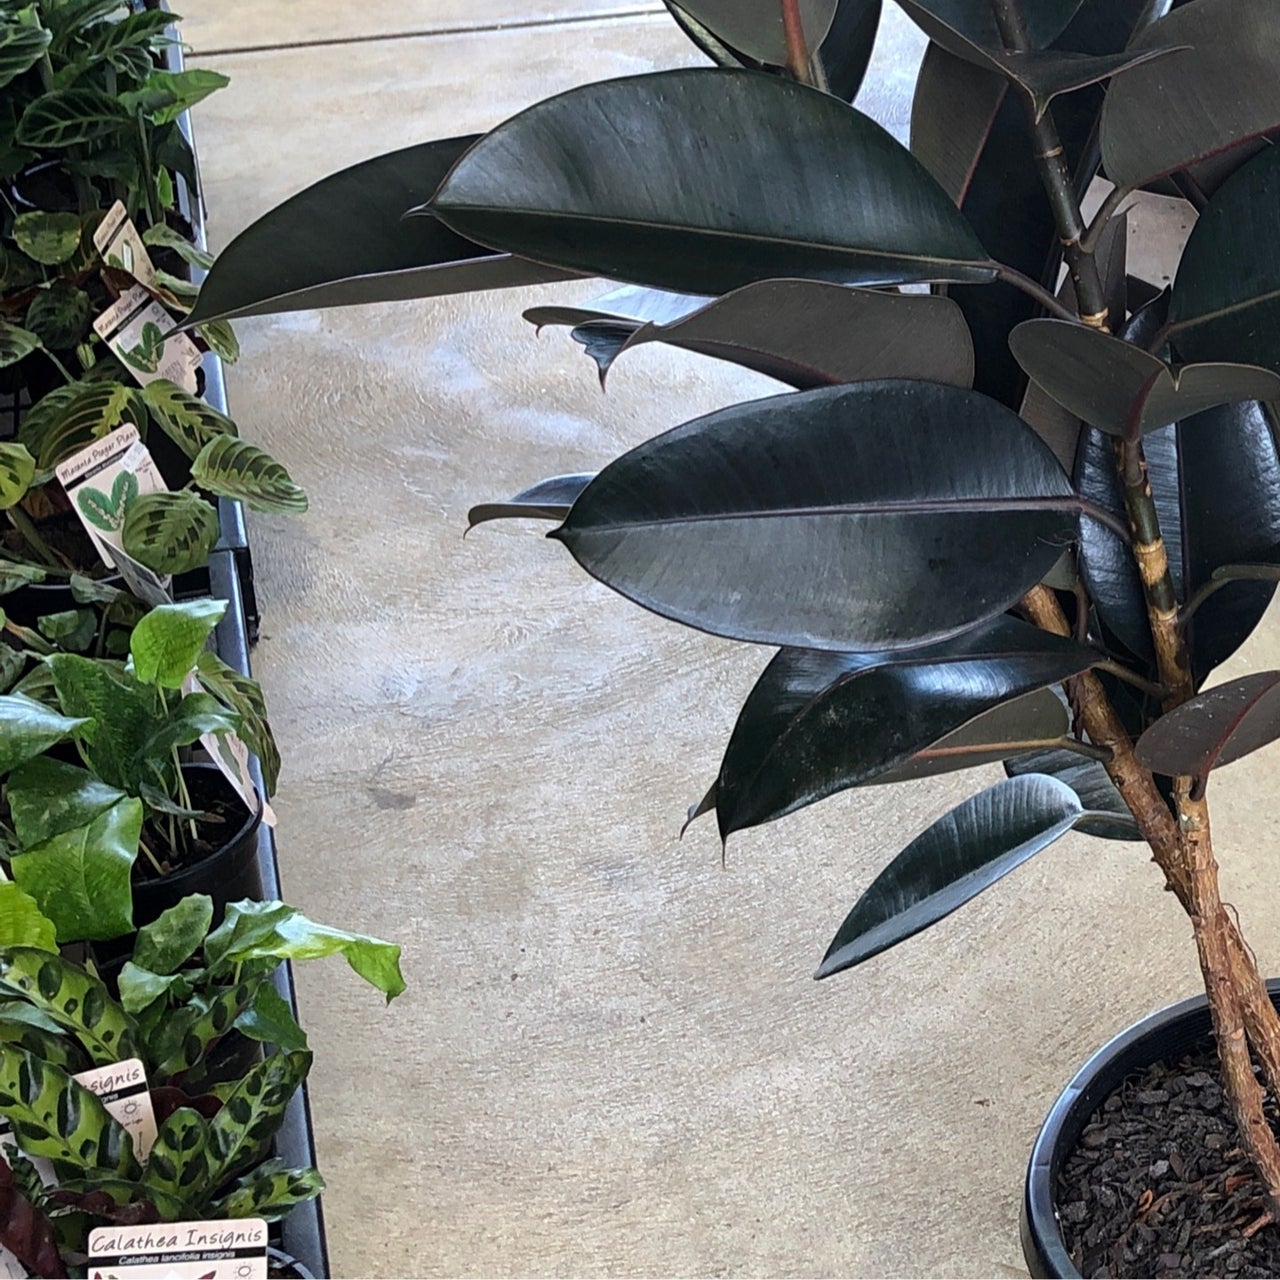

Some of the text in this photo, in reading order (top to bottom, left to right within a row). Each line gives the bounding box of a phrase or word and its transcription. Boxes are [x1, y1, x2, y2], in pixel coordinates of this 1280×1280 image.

[88, 1068, 140, 1095] signis
[91, 1228, 263, 1253] Calathea Insignis
[118, 1254, 159, 1266] Calathea
